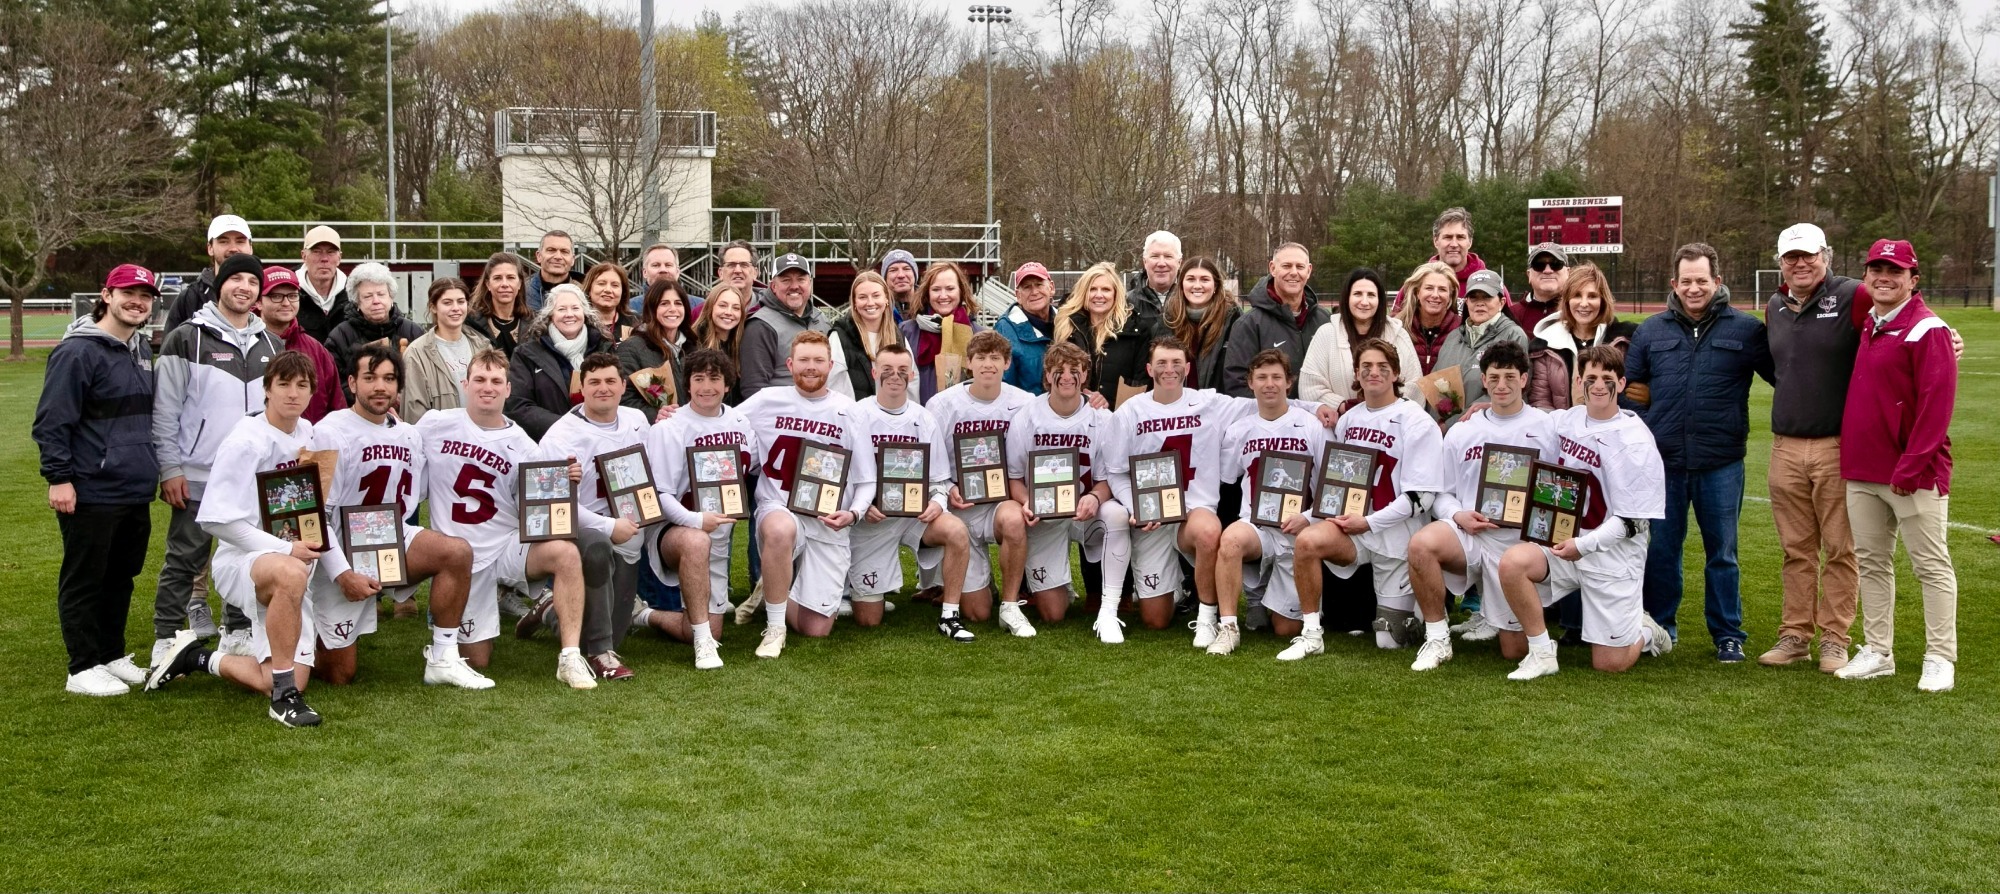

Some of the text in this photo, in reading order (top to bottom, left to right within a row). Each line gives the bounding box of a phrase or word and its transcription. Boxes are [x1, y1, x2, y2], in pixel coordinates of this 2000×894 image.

[1542, 198, 1608, 207] VASSAR BREWERS
[953, 419, 1010, 434] BREWER
[1136, 414, 1202, 436] BREWERS
[1034, 433, 1091, 448] BREWER
[1242, 437, 1308, 456] BREWERS
[362, 444, 412, 467] BREWE
[440, 440, 513, 476] BREWERS
[452, 463, 499, 525] 5
